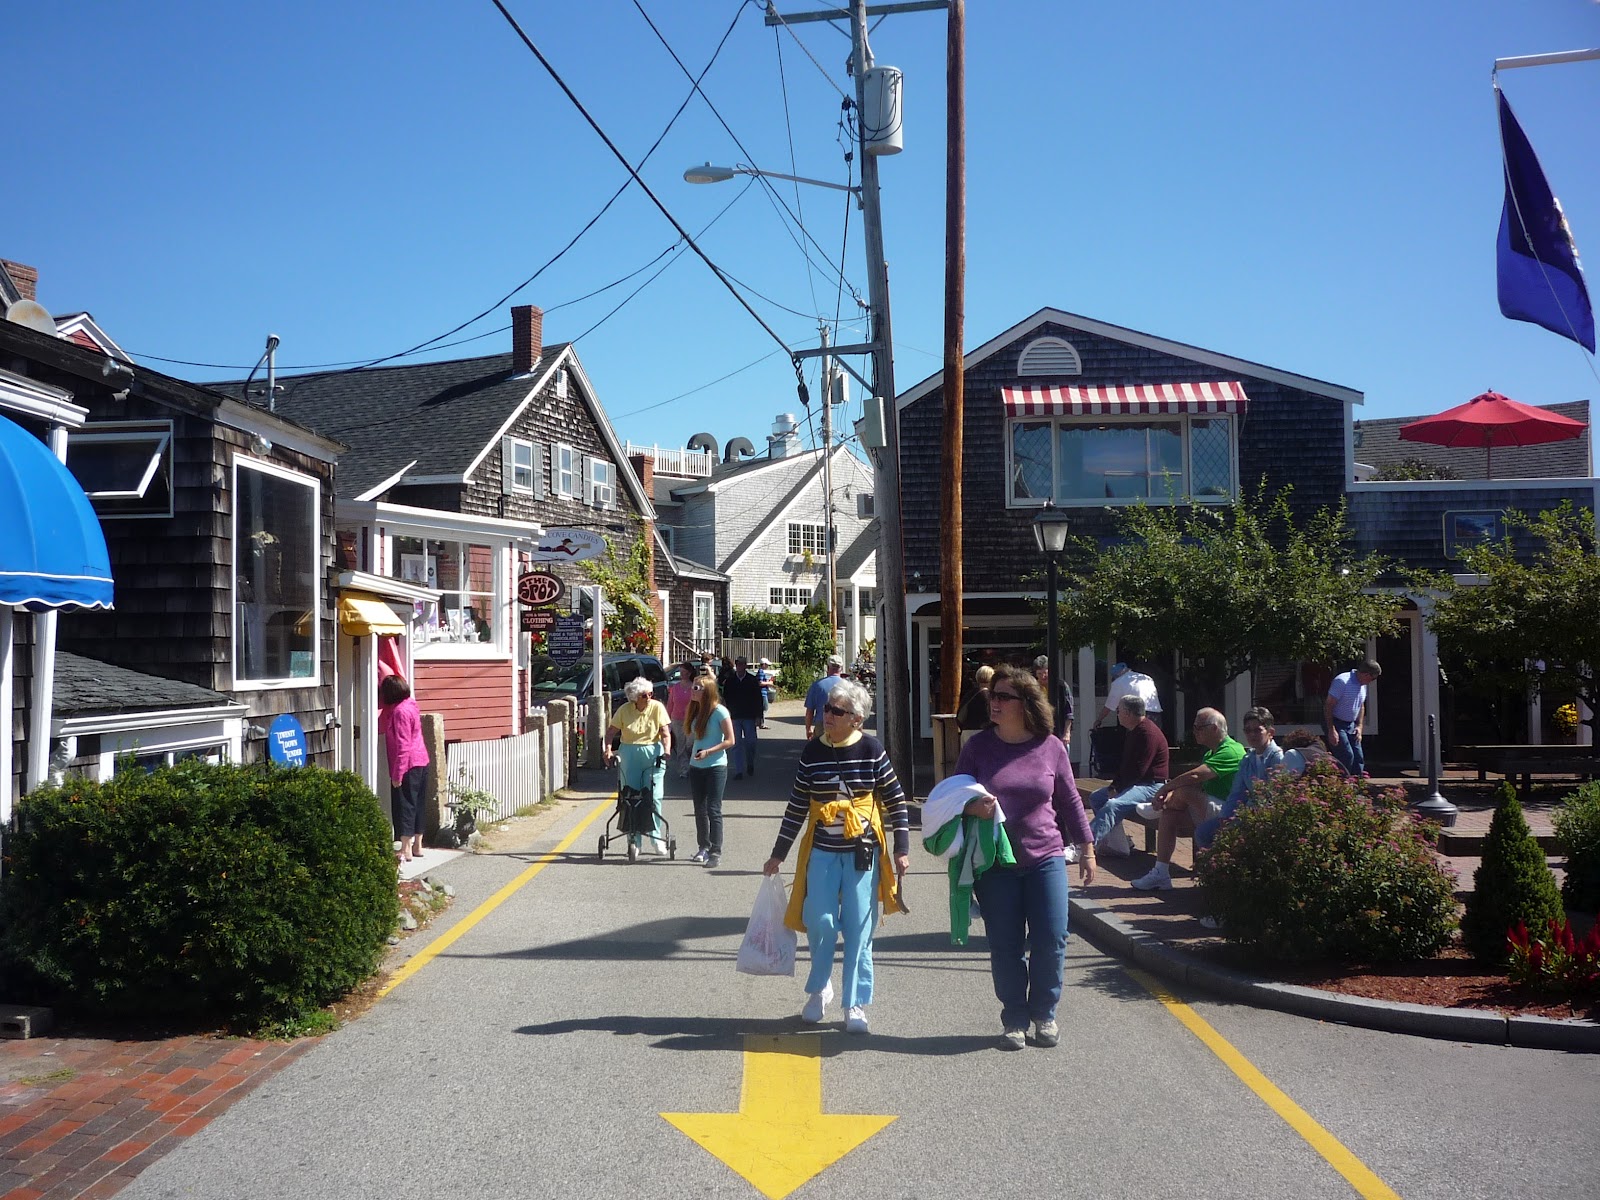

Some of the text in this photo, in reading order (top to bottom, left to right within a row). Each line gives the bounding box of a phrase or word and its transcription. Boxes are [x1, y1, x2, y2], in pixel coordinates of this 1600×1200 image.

[568, 532, 599, 545] CANDIES
[526, 577, 548, 585] THE
[518, 580, 557, 601] SPOT
